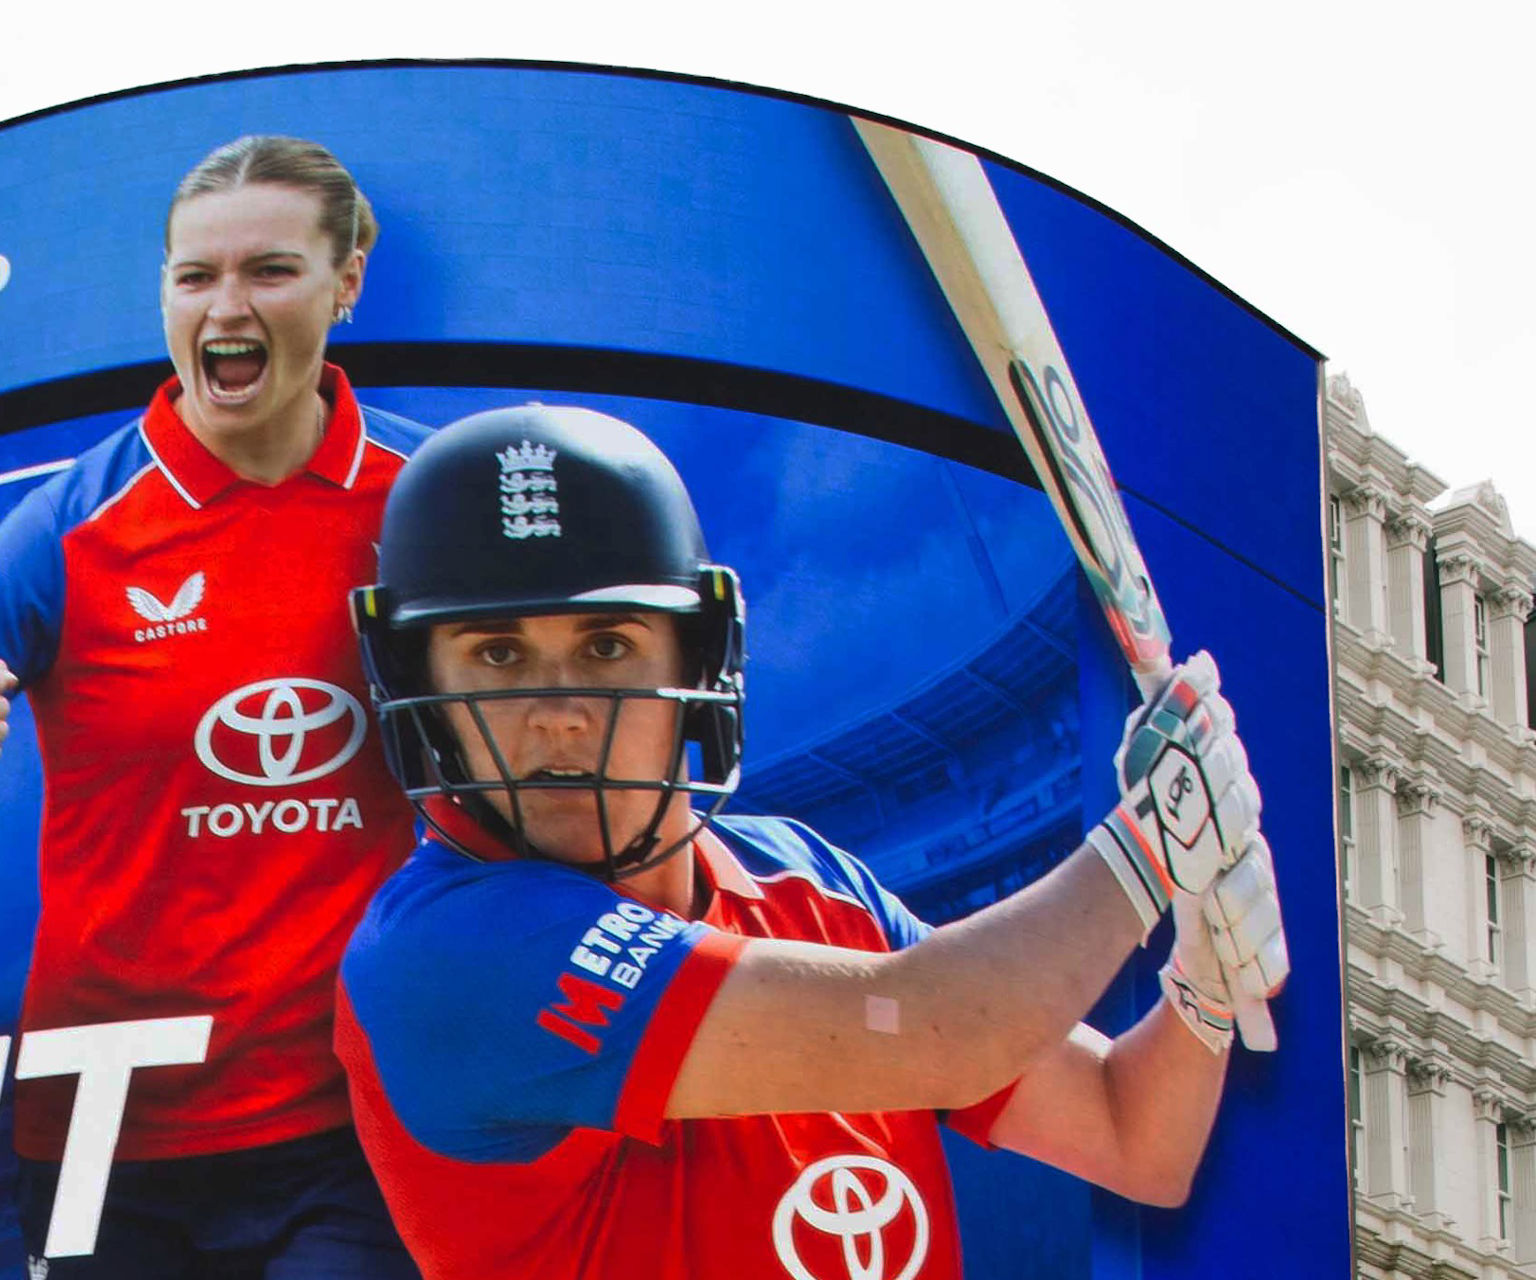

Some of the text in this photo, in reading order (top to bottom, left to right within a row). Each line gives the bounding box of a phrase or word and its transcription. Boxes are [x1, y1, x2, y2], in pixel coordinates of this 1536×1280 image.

[134, 617, 209, 644] CASTORE
[180, 796, 365, 838] TOYOTA
[610, 914, 690, 990] BANK
